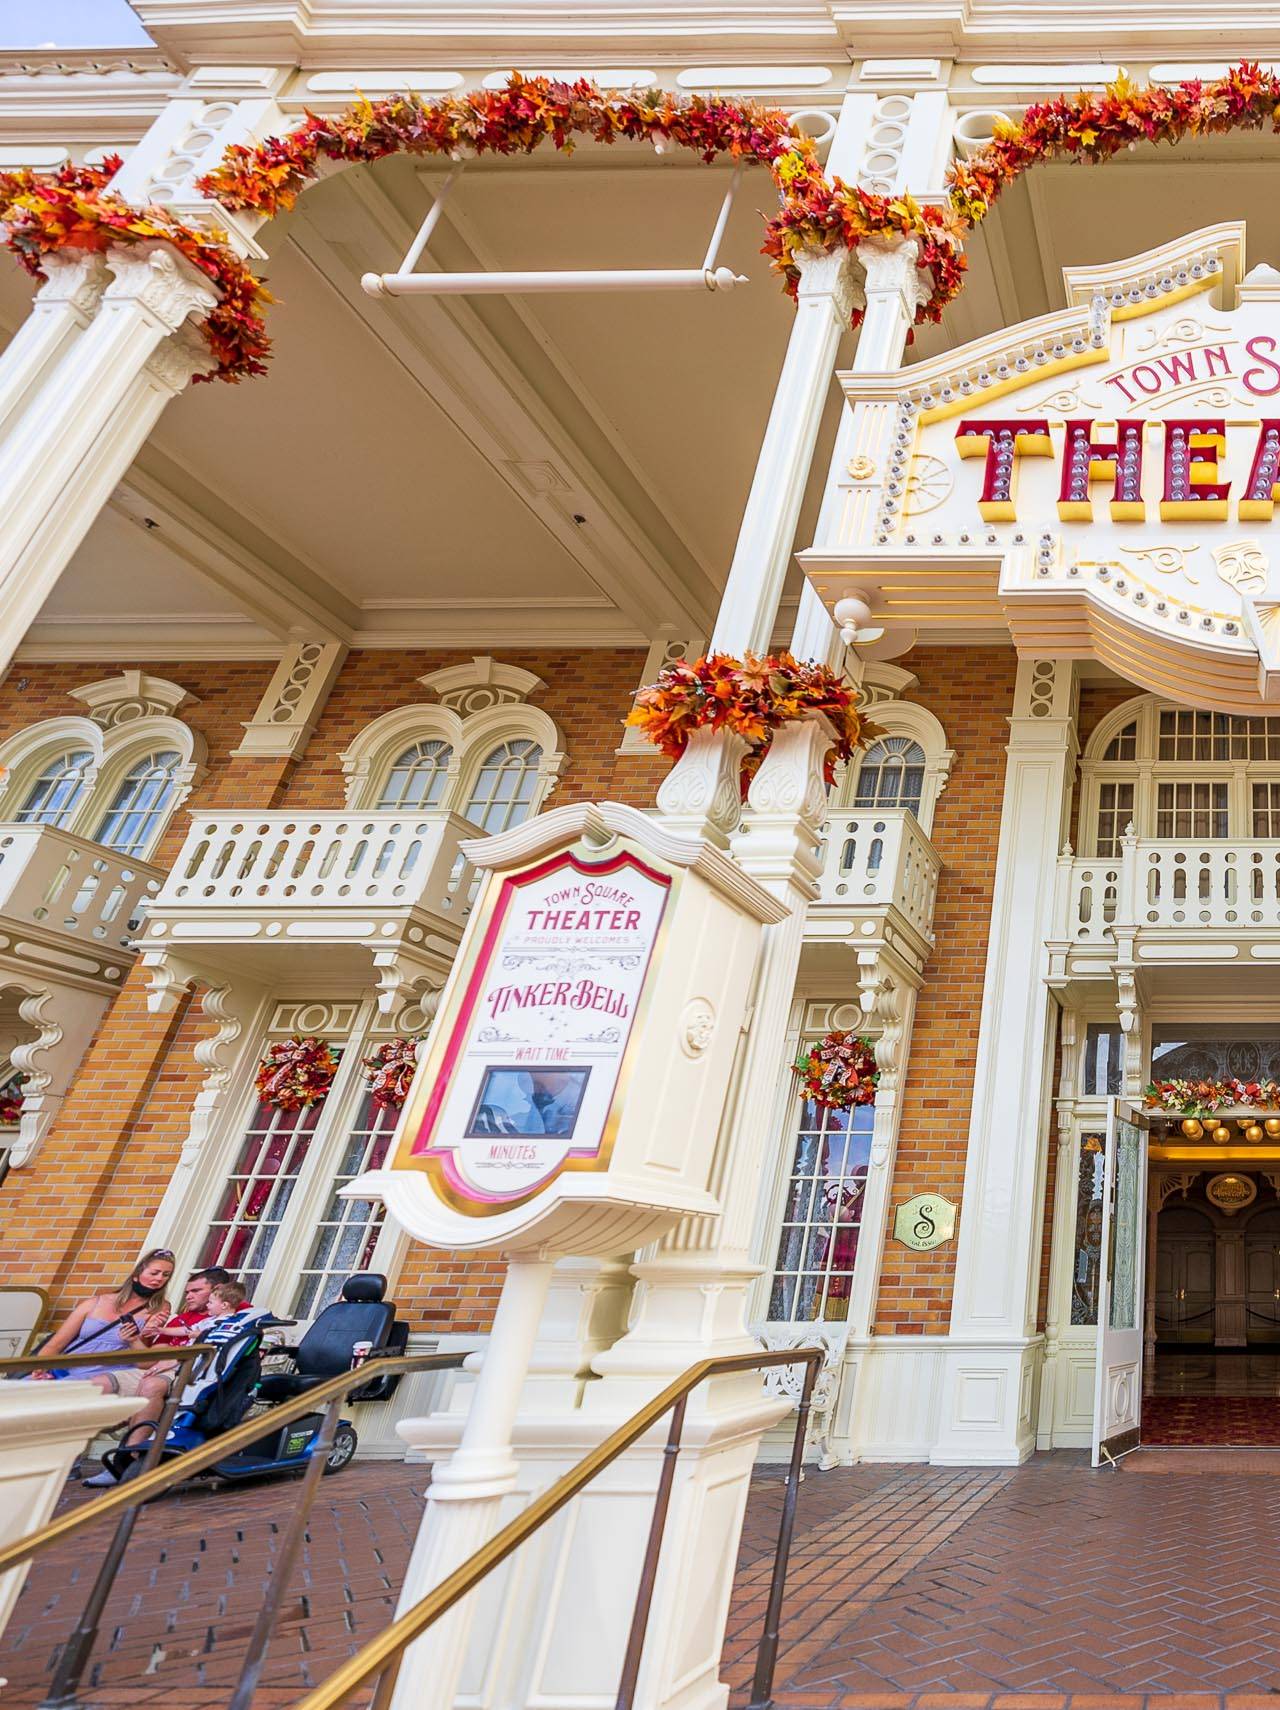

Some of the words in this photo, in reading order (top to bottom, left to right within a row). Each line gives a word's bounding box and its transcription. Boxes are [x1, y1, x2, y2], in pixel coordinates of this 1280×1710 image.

[1106, 346, 1233, 403] TOWN
[544, 886, 581, 907] TOWN
[580, 882, 635, 908] SQUARE
[527, 910, 641, 930] THEATER
[523, 936, 571, 944] PROUDLY
[575, 936, 630, 944] WELCOMES
[487, 982, 572, 1019] TINKER
[570, 979, 629, 1019] BELL
[515, 1047, 542, 1061] WAIT
[543, 1047, 570, 1061] TIME
[489, 1144, 537, 1160] MINUTES
